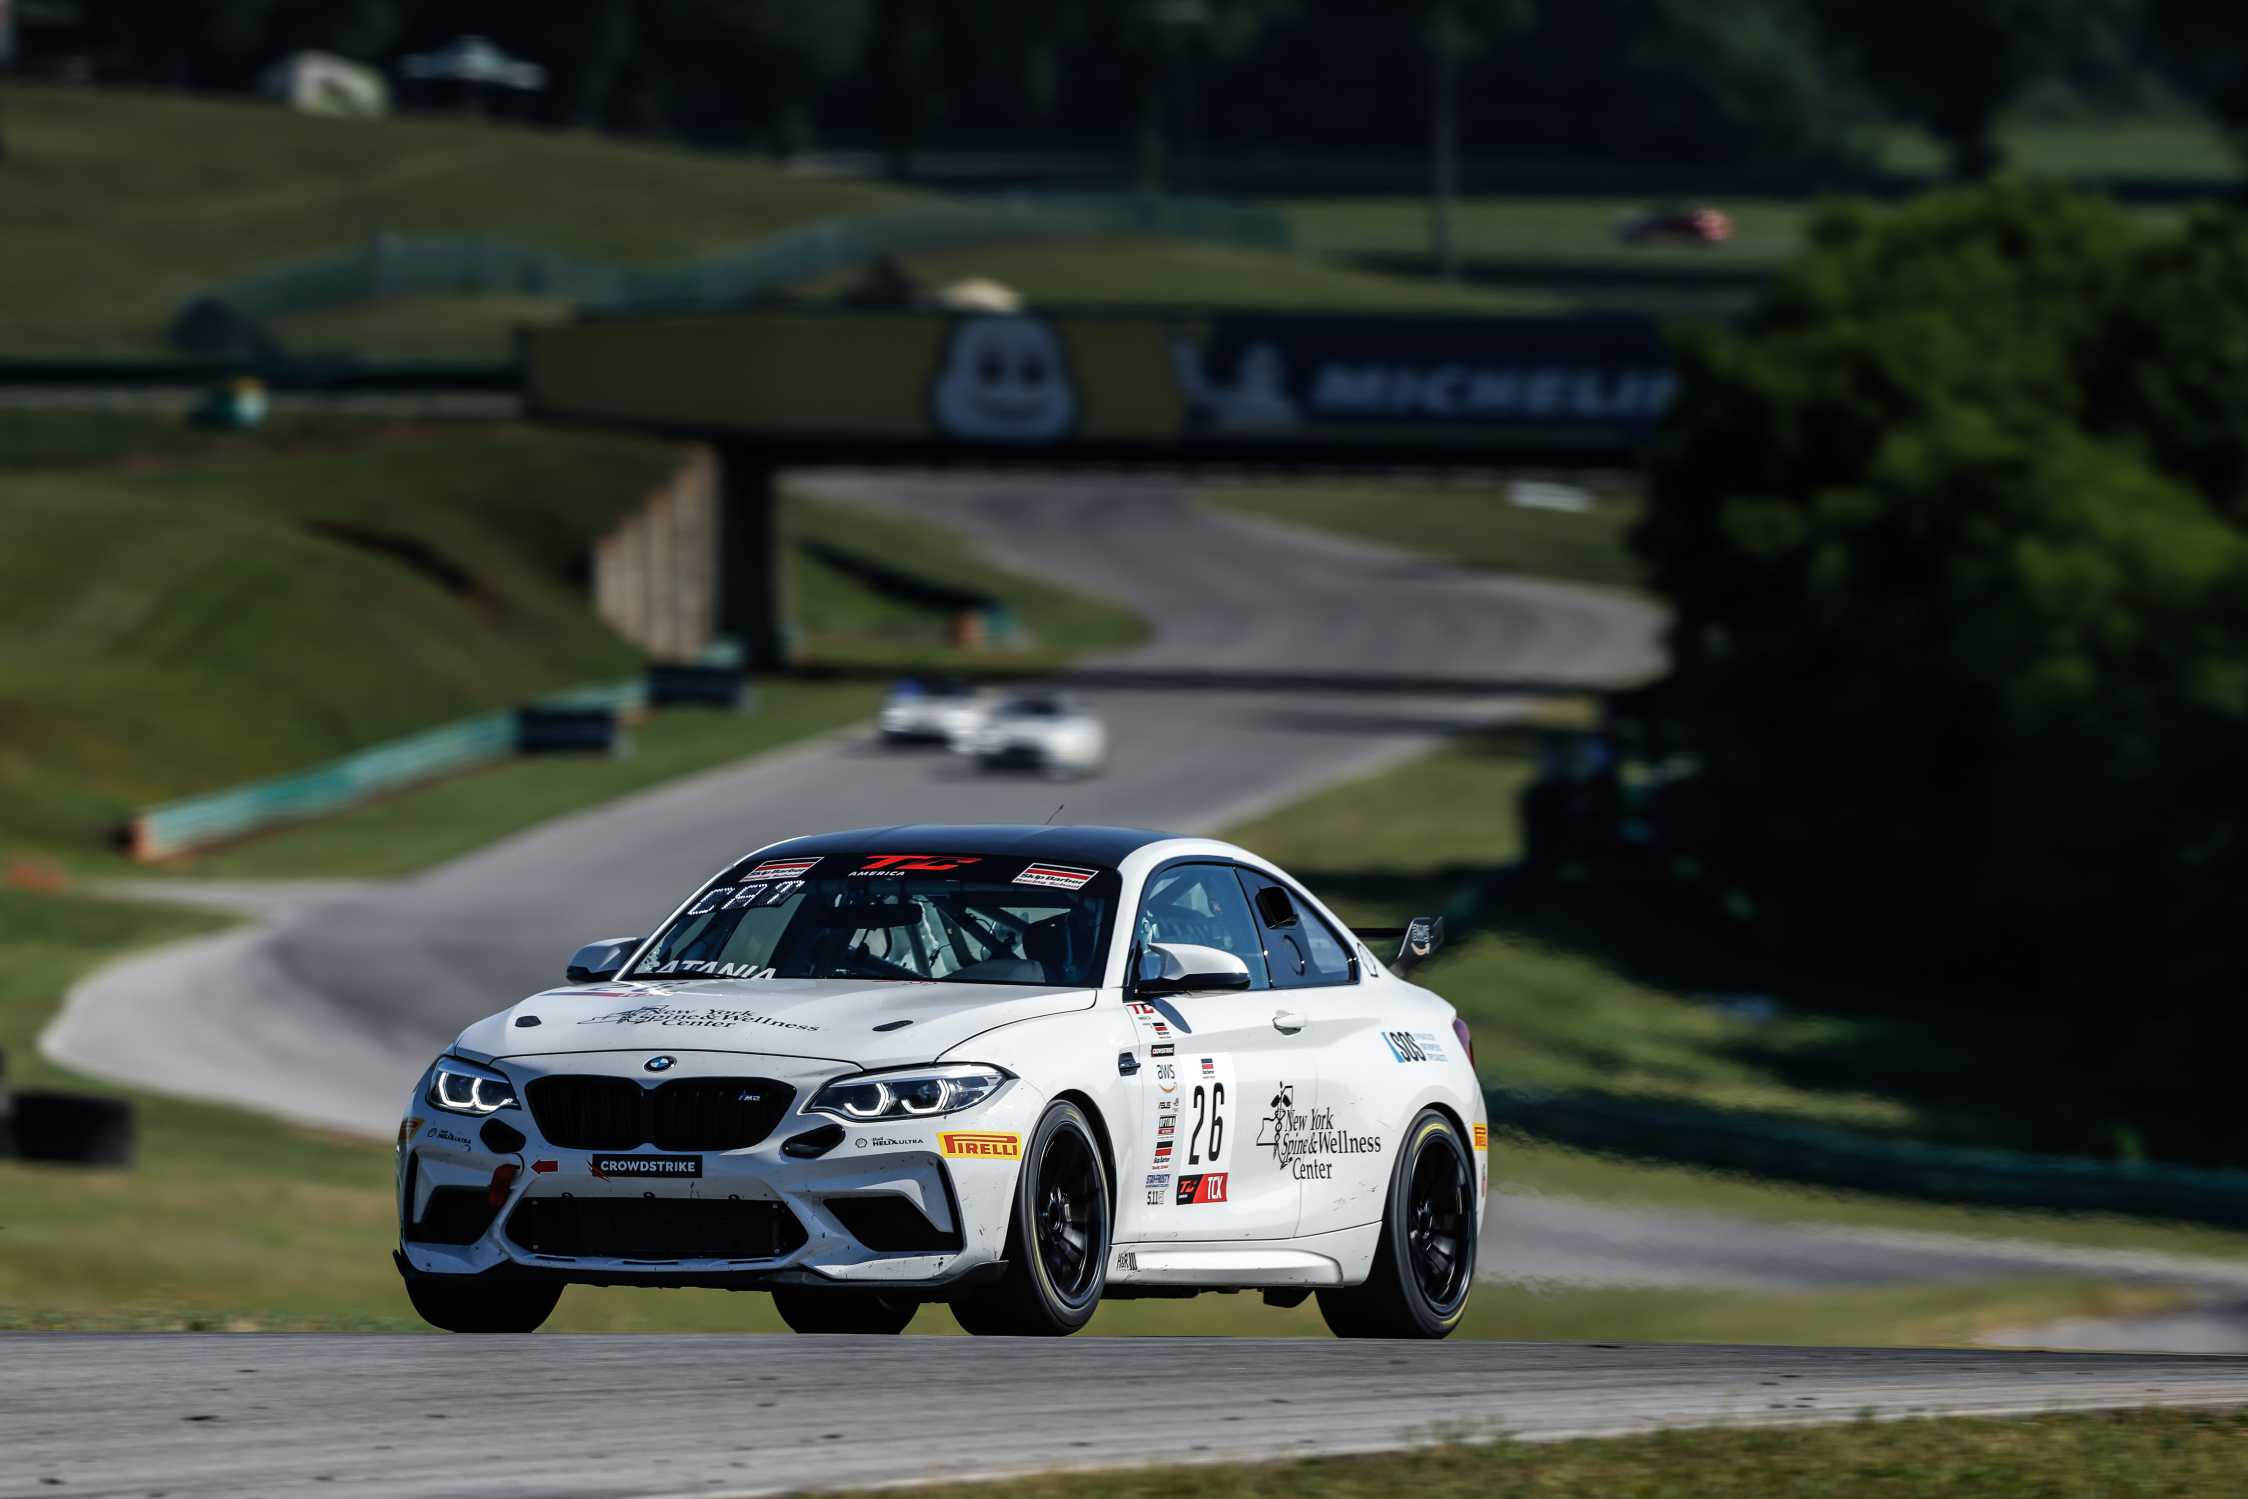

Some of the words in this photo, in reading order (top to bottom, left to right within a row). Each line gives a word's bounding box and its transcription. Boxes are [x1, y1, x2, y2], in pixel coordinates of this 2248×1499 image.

[1046, 875, 1085, 885] Barber
[648, 960, 777, 980] ATANIA
[708, 1009, 753, 1017] York
[661, 1019, 737, 1028] Center
[1157, 1064, 1176, 1079] aws
[1188, 1082, 1225, 1165] 26
[1285, 1109, 1307, 1131] New
[1310, 1107, 1334, 1130] York
[943, 1134, 1018, 1156] PIRELLI
[600, 1160, 696, 1172] CROWDSTRIKE
[1292, 1157, 1332, 1180] Center
[1207, 1175, 1224, 1200] TCX
